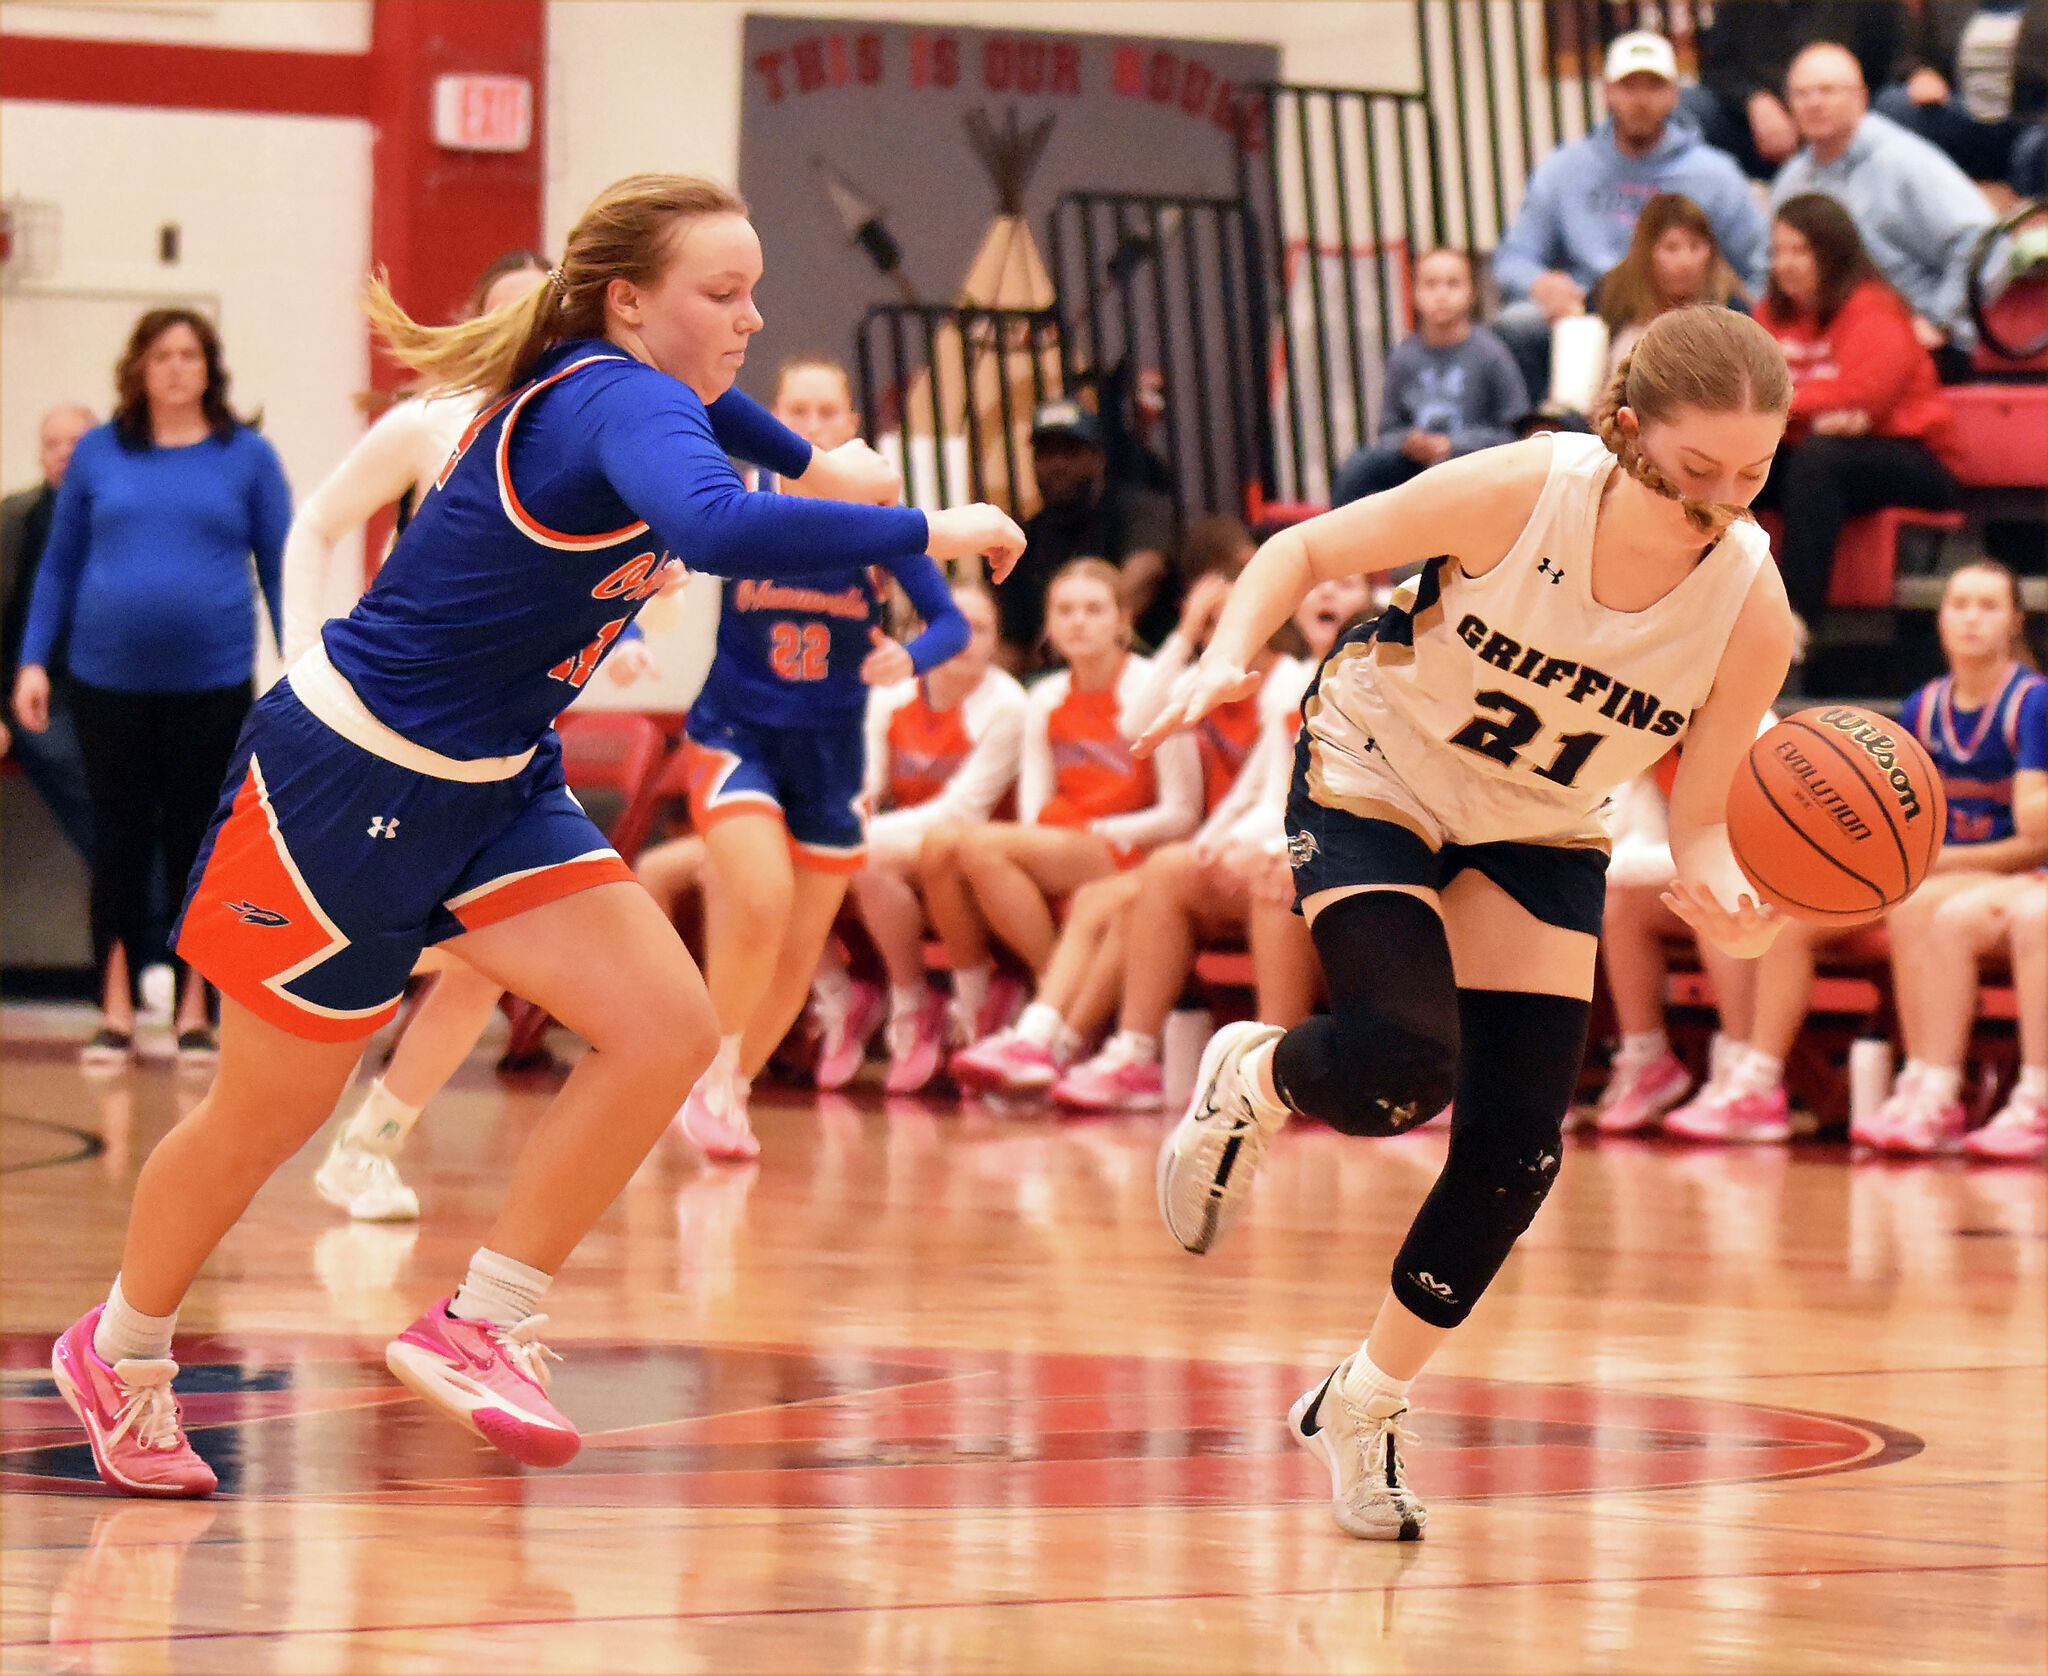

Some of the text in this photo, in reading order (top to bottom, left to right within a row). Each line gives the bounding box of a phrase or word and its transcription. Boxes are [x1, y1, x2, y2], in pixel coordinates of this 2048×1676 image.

[754, 32, 884, 103] THIS
[910, 33, 958, 88] IS
[982, 37, 1081, 96] OUR
[769, 621, 831, 682] 22
[1456, 613, 1686, 737] GRIFFINS
[1444, 688, 1609, 789] 21
[1815, 708, 1921, 823] Wilson
[1776, 741, 1873, 841] EVOLUTION
